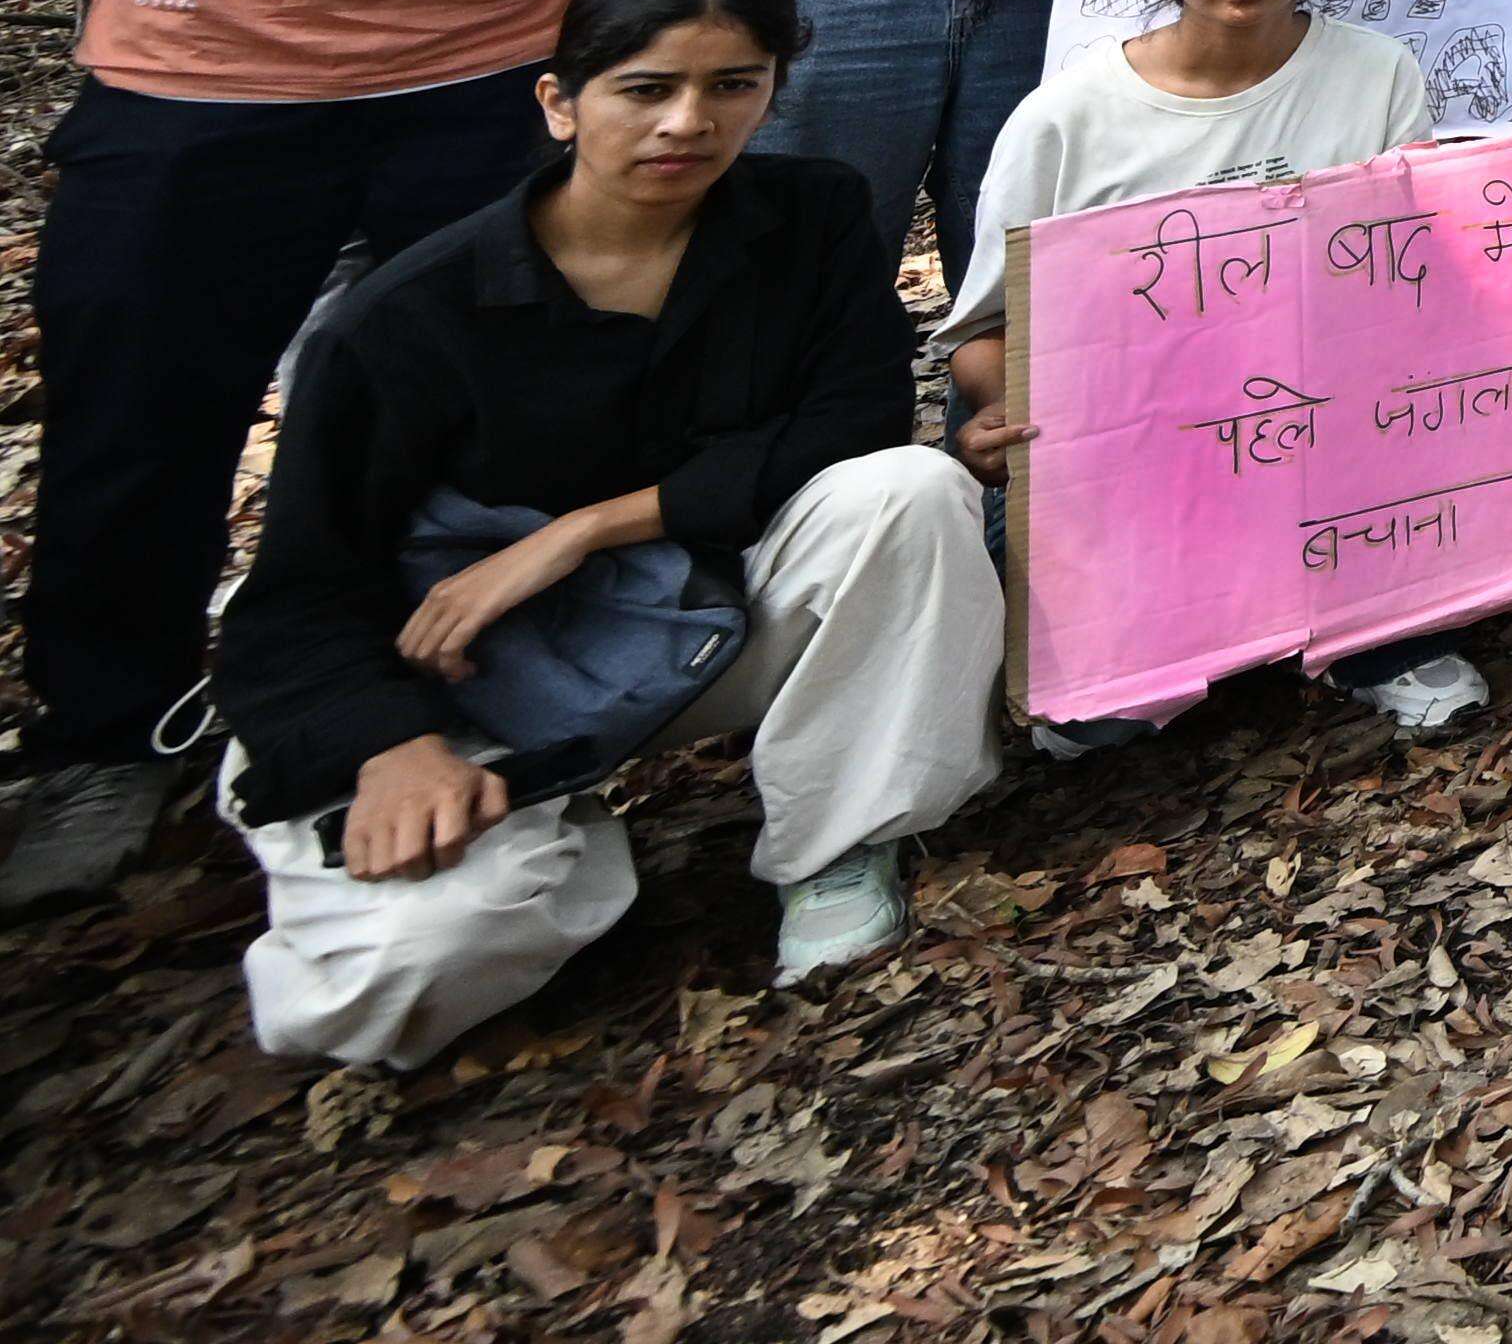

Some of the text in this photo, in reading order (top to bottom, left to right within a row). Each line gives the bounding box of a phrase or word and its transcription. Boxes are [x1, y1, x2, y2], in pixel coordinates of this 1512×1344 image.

[1129, 209, 1298, 320] रील
[1328, 213, 1438, 310] बाद
[1194, 377, 1334, 474] पहले
